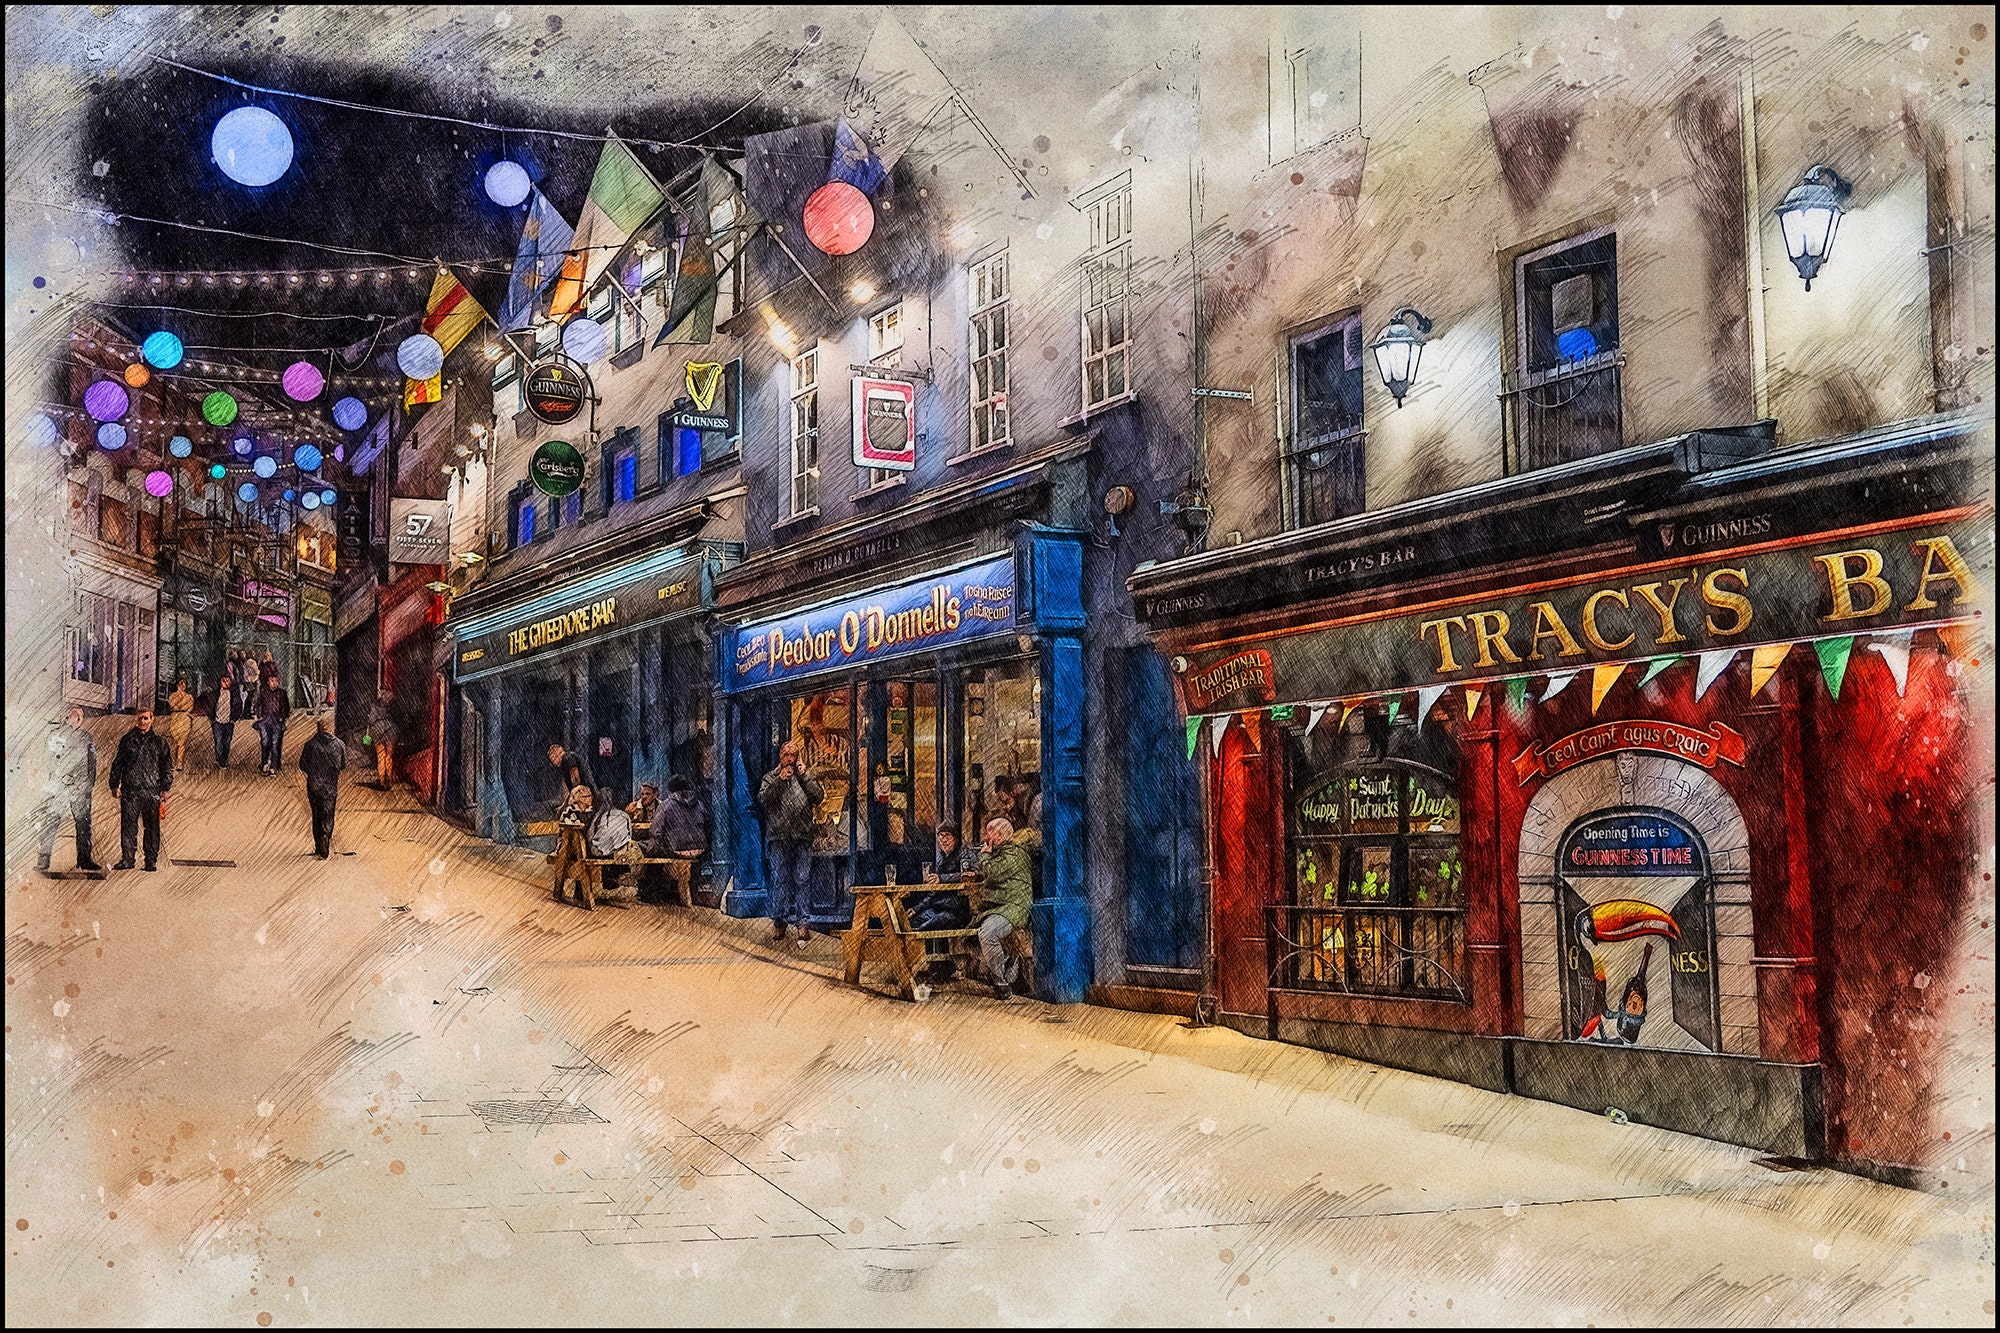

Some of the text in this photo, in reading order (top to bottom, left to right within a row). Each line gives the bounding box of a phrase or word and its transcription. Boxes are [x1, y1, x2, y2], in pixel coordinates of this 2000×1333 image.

[529, 379, 581, 398] GUINNESS
[681, 413, 729, 428] GUINNESS
[536, 457, 580, 477] Carlsberg
[406, 514, 433, 536] 57
[1682, 513, 1773, 546] GUINNESS
[1304, 546, 1416, 582] TRACY'S BAR
[1156, 593, 1205, 615] GUINNESS
[507, 626, 529, 656] THE
[591, 597, 617, 629] BAR
[767, 584, 961, 676] Peadar O'Donnell's
[1420, 567, 1756, 674] TRACY'S
[1191, 652, 1266, 698] TRADITIONAL
[1208, 669, 1266, 704] IRISH BAR
[1623, 727, 1660, 746] agus
[1358, 774, 1394, 796] Saint
[1301, 798, 1341, 823] Happy
[1409, 788, 1449, 825] Day
[1583, 824, 1670, 843] Opening Time is
[1571, 846, 1693, 866] GUINNESS TIME
